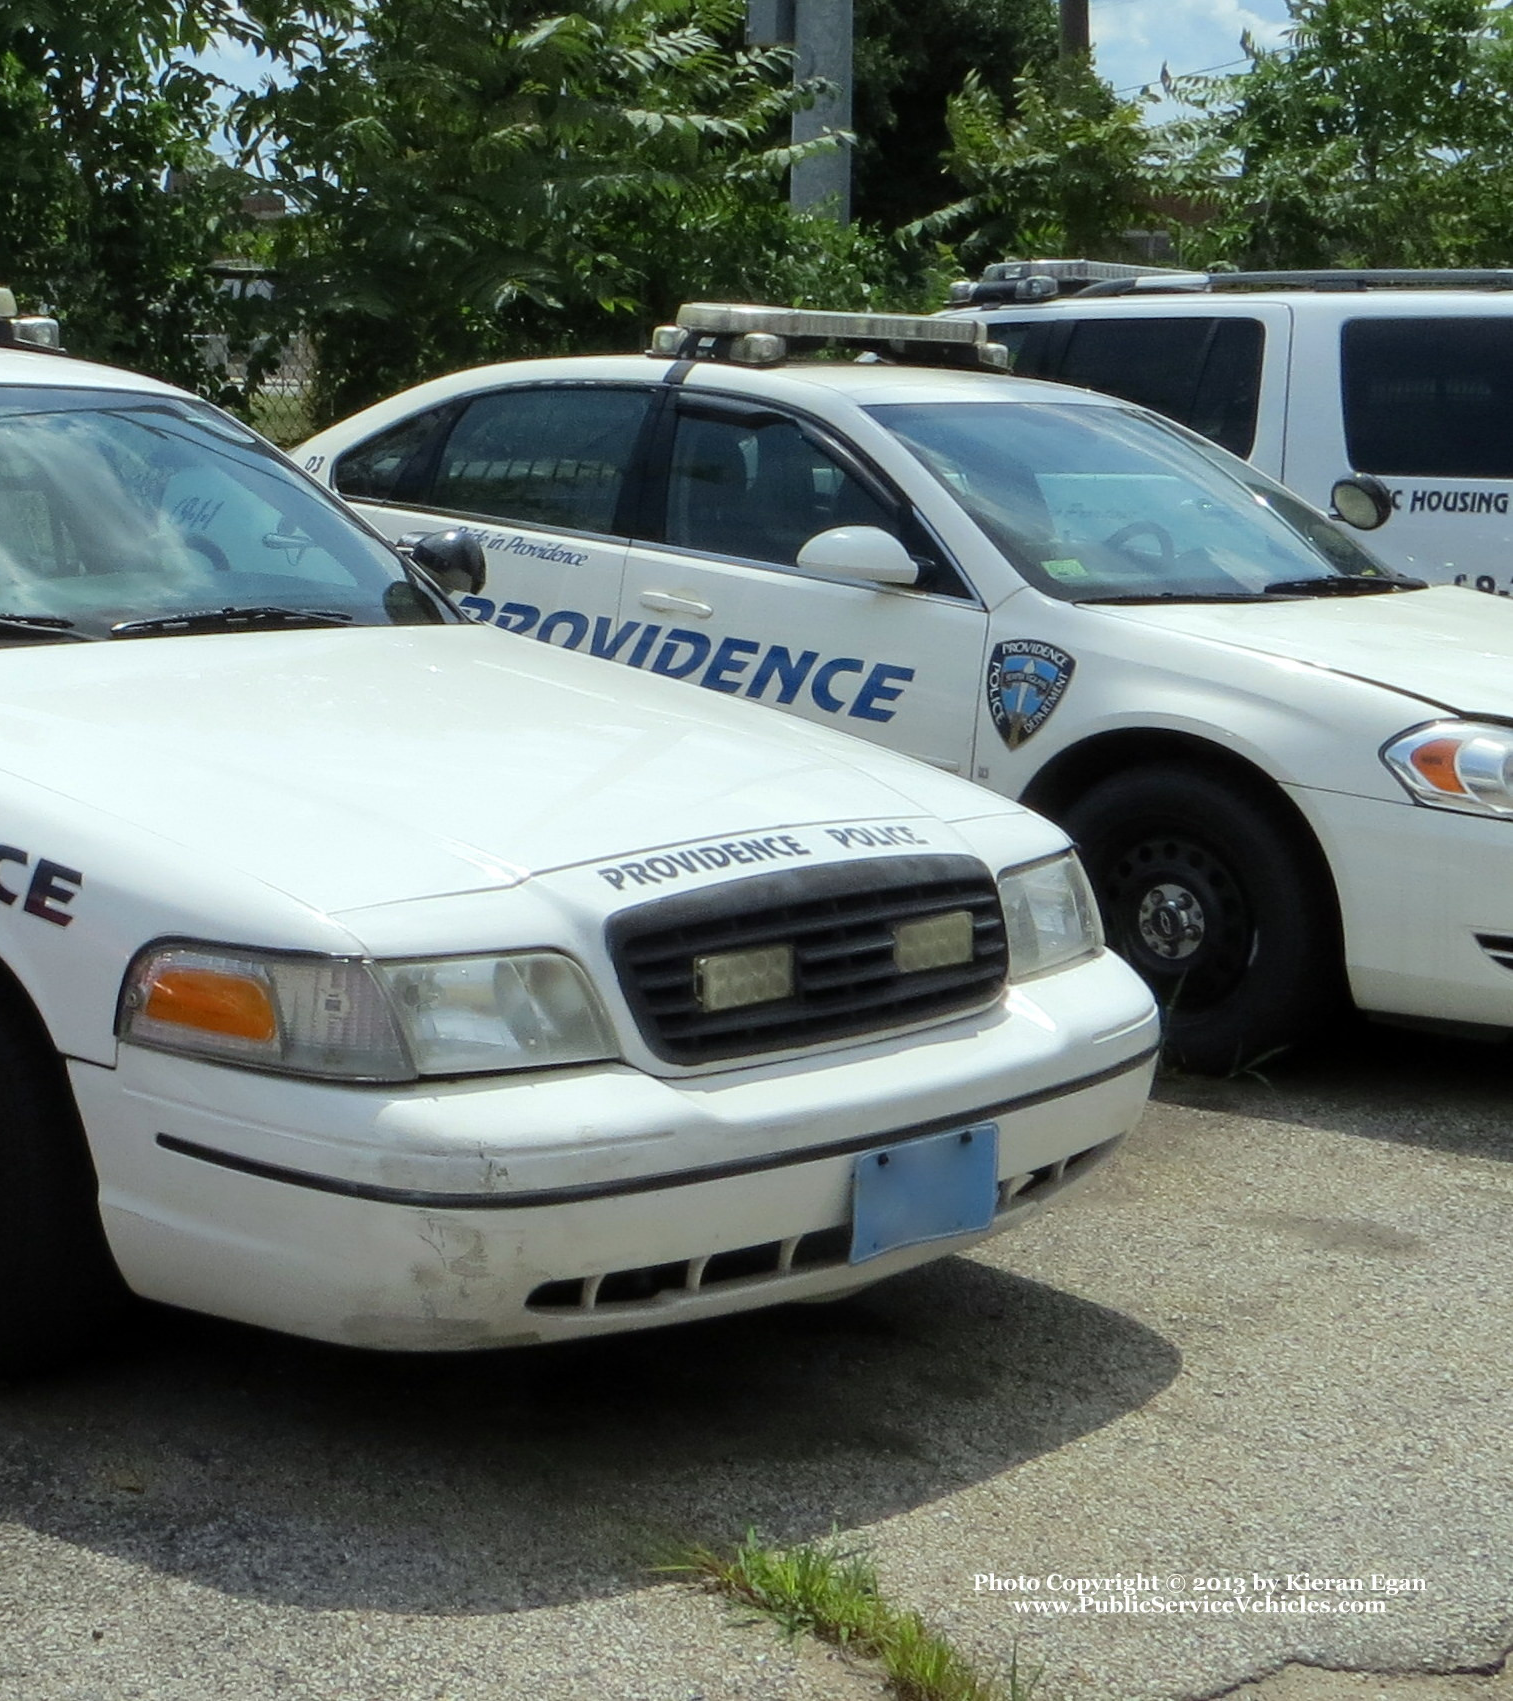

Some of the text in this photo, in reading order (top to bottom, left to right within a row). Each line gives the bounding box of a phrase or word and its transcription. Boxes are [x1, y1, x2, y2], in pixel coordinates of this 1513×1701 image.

[304, 455, 326, 474] 03
[1410, 490, 1510, 514] HOUSING
[486, 533, 505, 550] in
[502, 536, 589, 567] Providence
[1001, 641, 1069, 668] PROVIDENCE
[989, 661, 1006, 725] POLICE
[1024, 673, 1068, 733] DEPARTMENT
[597, 825, 929, 891] PROVIDENCE POLICE
